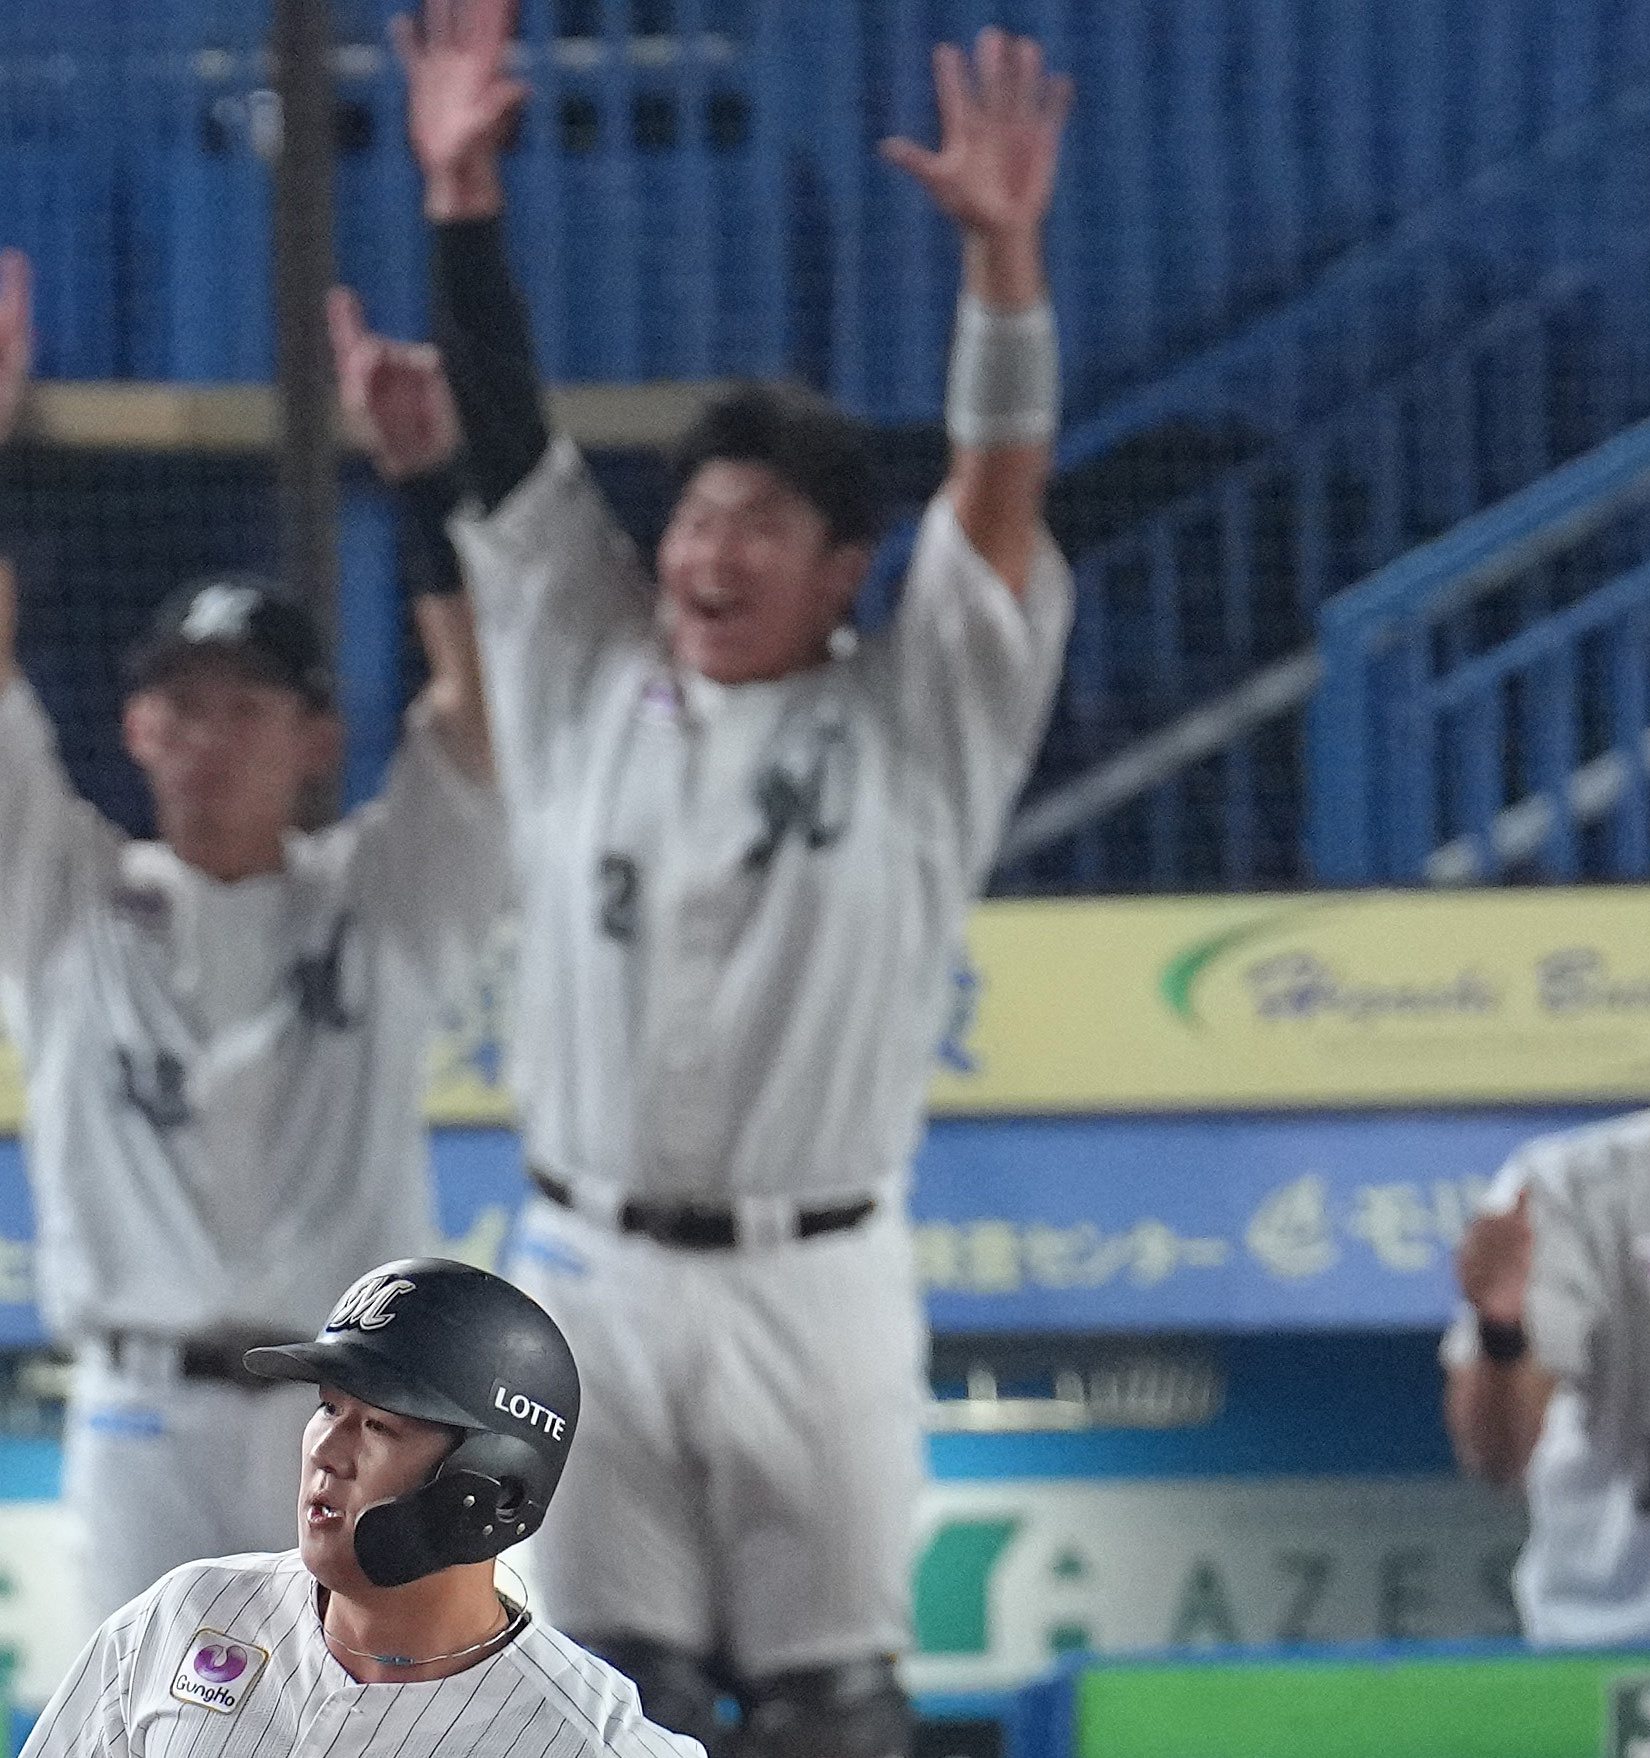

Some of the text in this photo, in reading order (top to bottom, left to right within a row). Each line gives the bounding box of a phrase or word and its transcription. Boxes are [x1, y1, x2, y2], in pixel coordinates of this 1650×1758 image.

[598, 852, 642, 945] 2
[324, 1273, 417, 1332] M
[493, 1385, 568, 1442] LOTTE
[175, 1673, 236, 1708] GungHo
